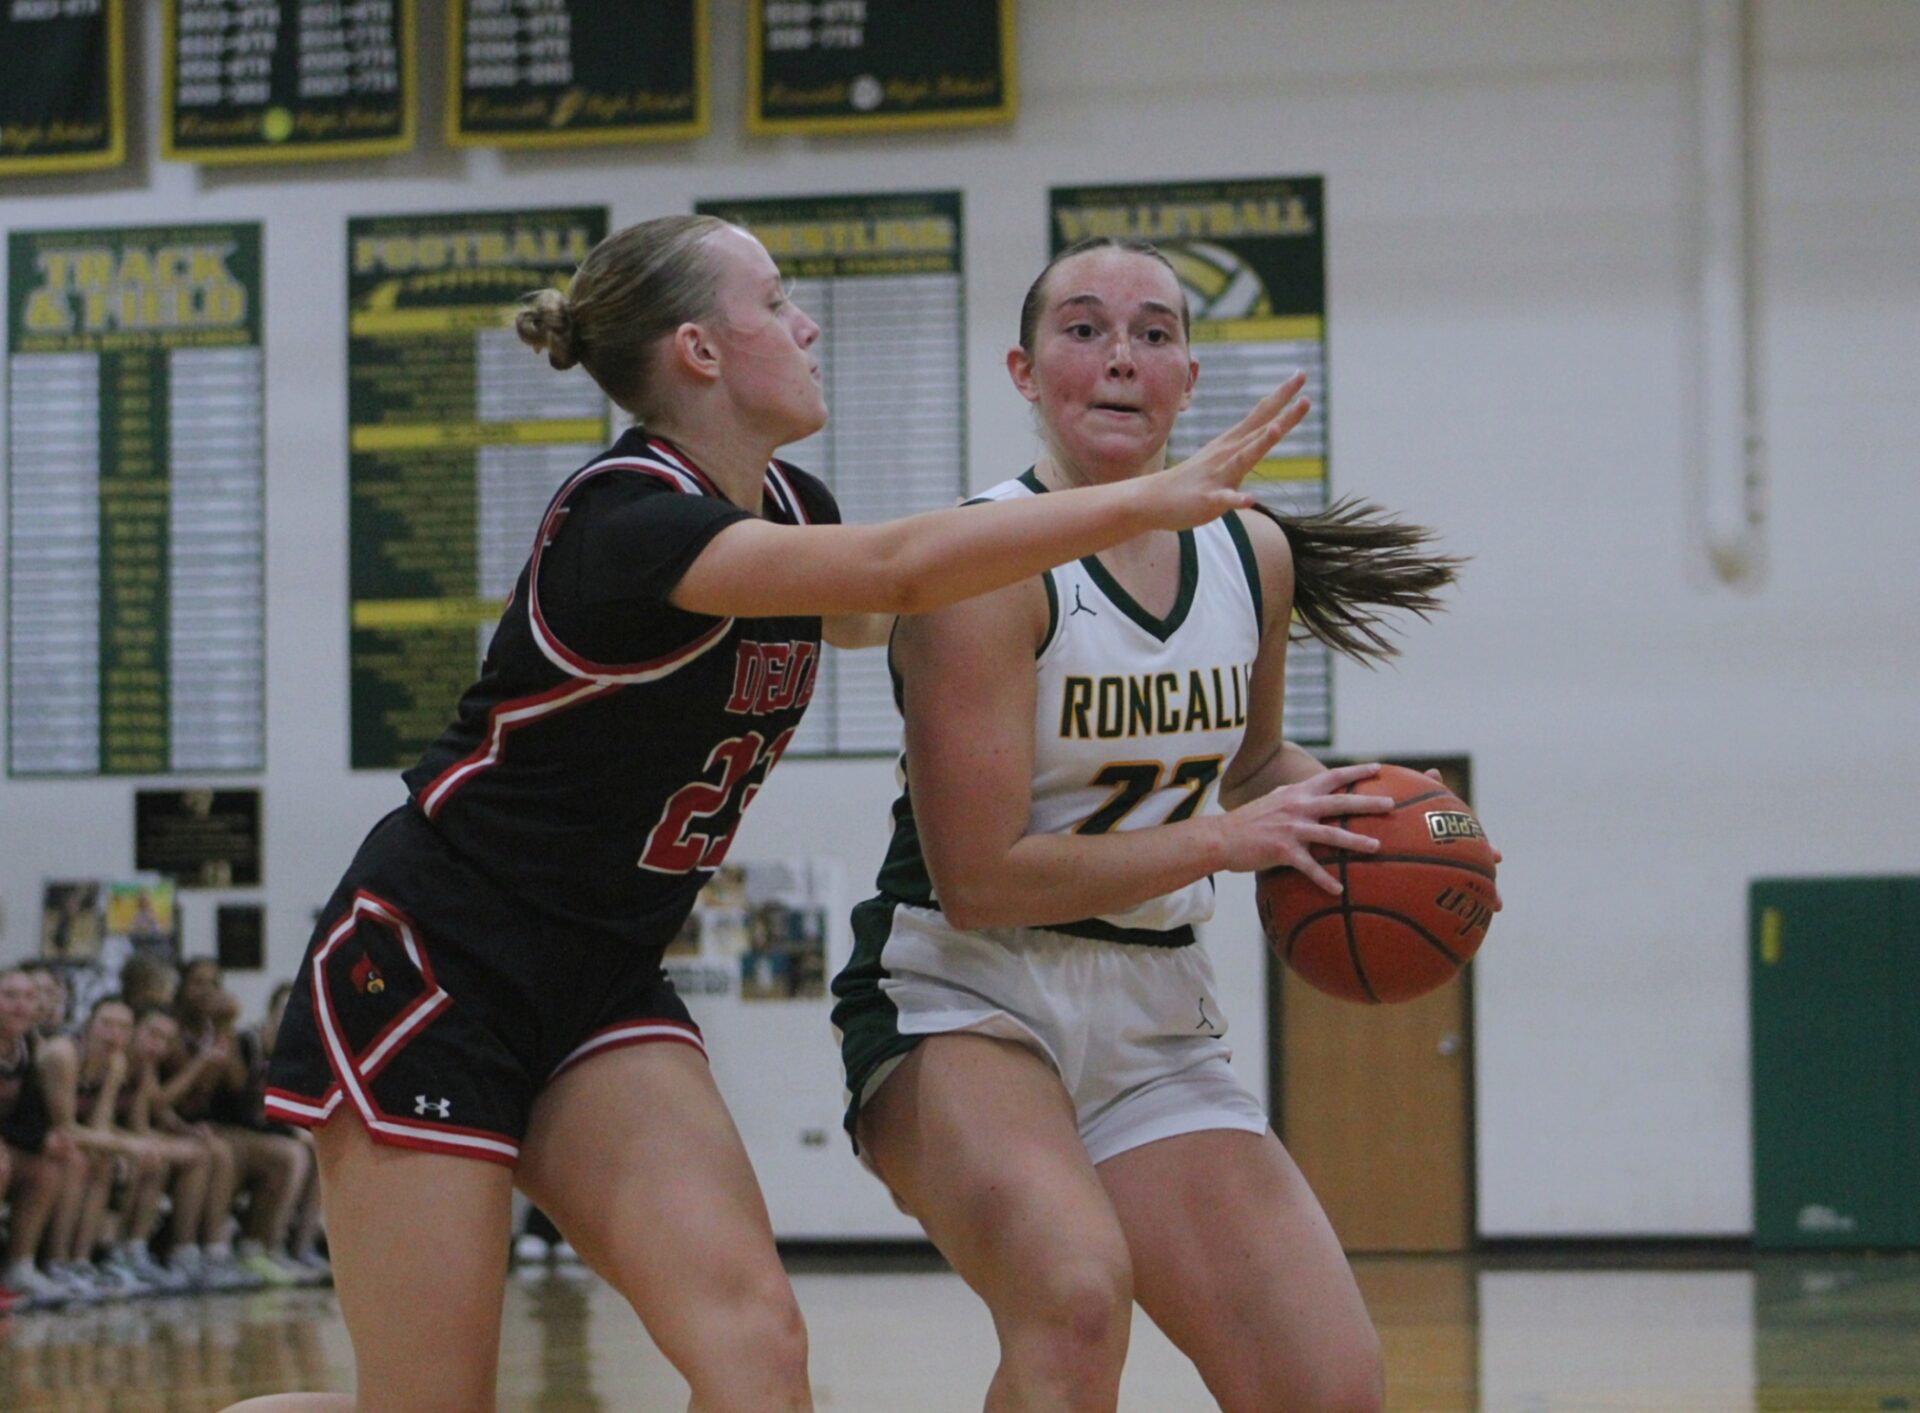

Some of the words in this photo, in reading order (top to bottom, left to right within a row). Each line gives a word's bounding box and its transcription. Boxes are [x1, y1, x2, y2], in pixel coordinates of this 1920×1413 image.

[38, 245, 236, 290] TRACK
[353, 227, 590, 275] FOOTBALL
[84, 284, 247, 329] FIELD
